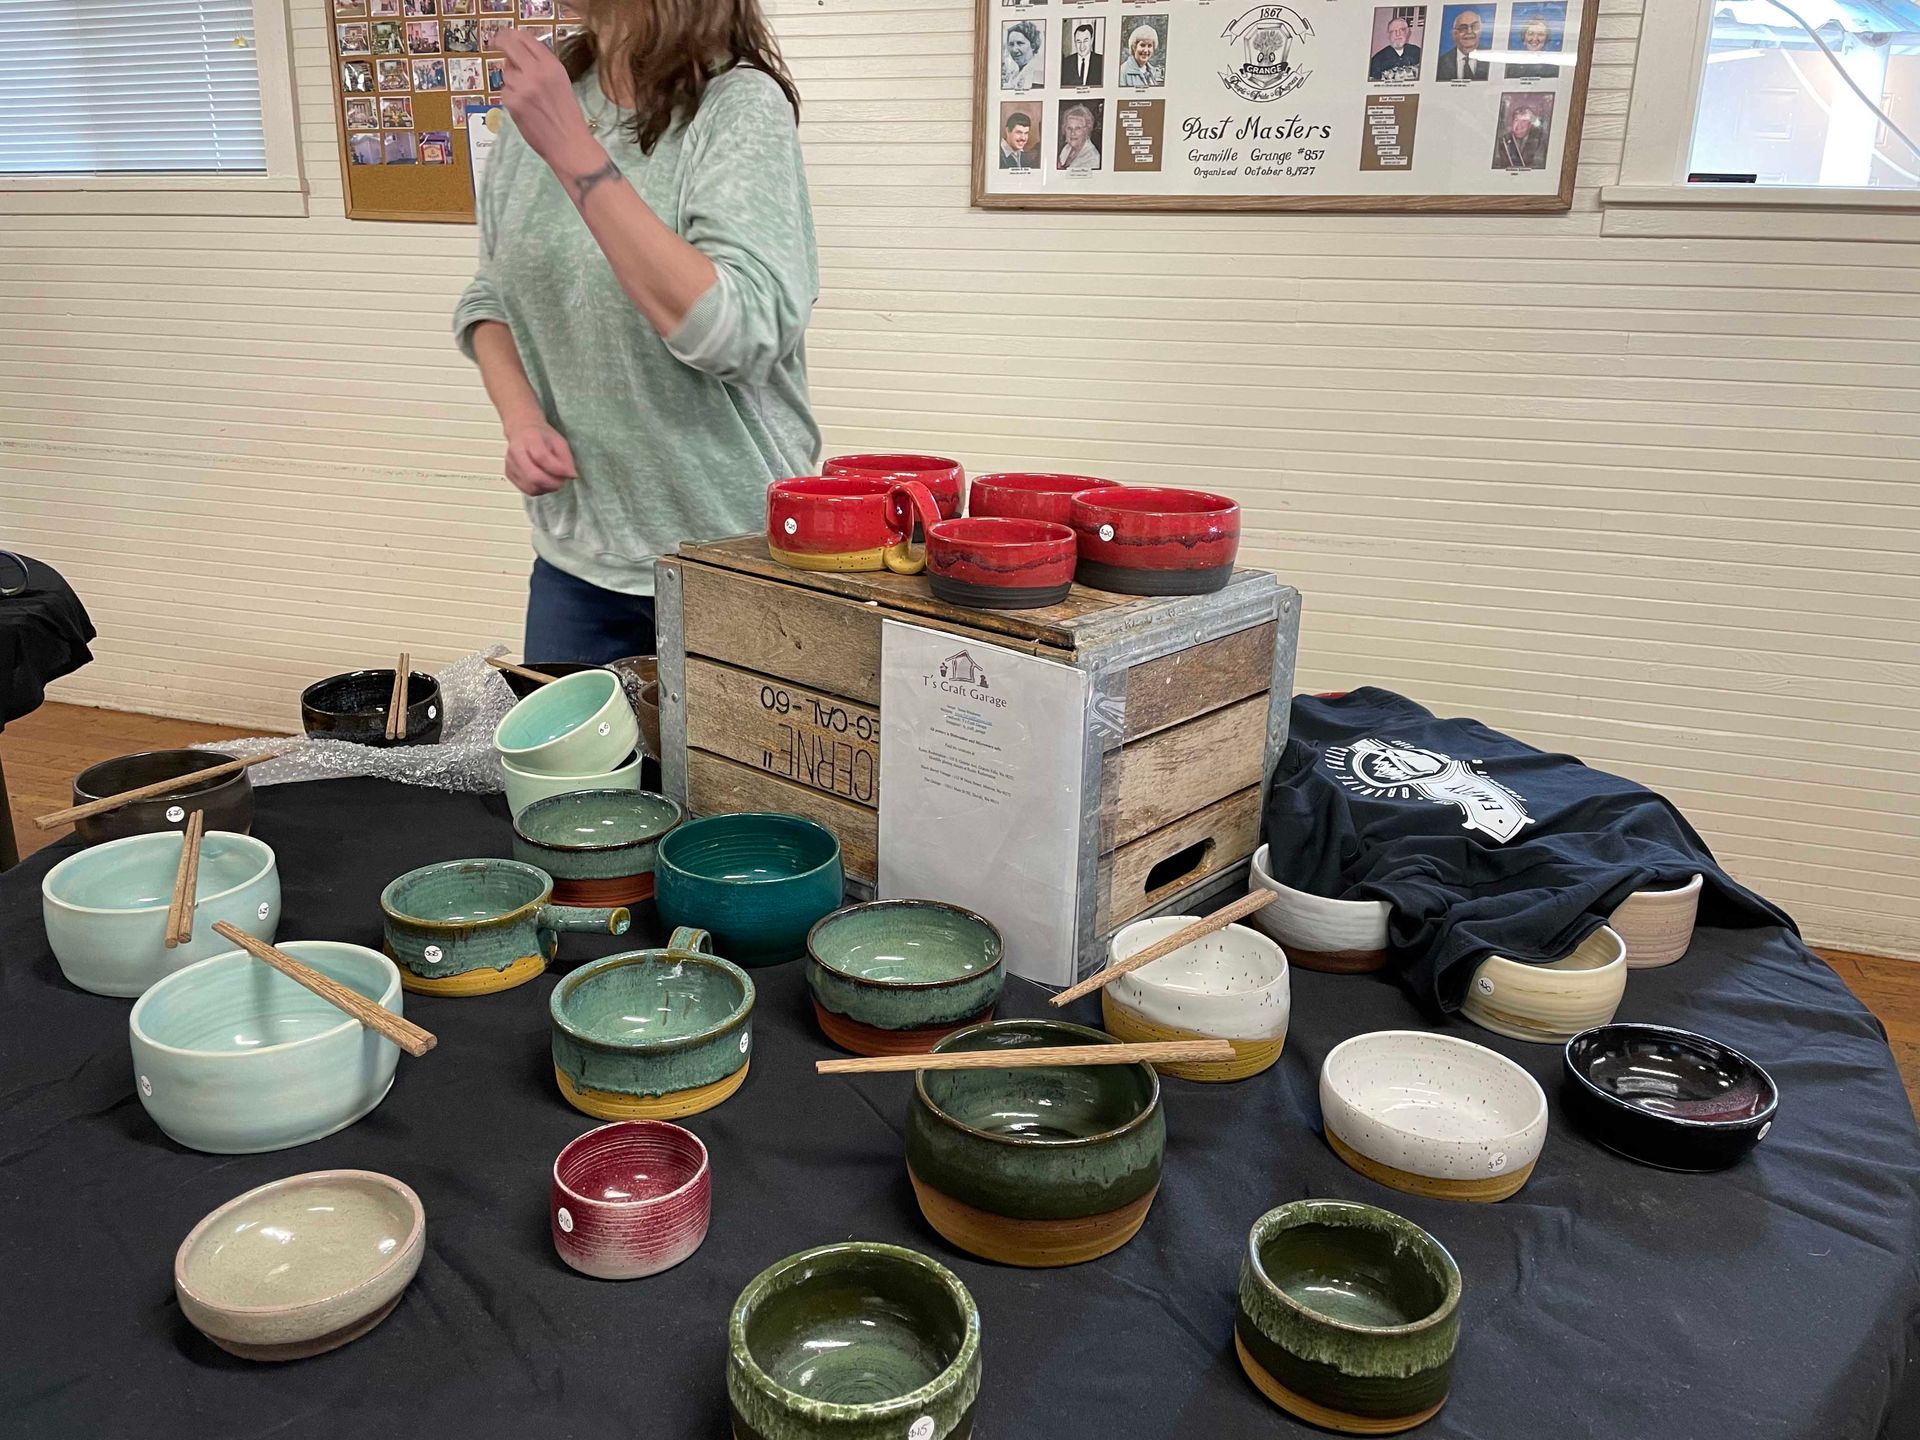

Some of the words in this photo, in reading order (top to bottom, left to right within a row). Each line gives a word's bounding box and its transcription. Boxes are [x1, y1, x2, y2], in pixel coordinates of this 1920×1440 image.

[1260, 8, 1283, 19] 1867
[1246, 65, 1282, 75] GRANGE
[1182, 115, 1234, 141] Past
[1236, 114, 1332, 140] Masters
[1188, 147, 1239, 162] Granville
[1250, 147, 1292, 165] Grange
[1297, 147, 1326, 161] #857
[1193, 167, 1238, 178] Organized
[1244, 166, 1283, 176] October
[923, 675, 937, 688] T's
[940, 681, 966, 697] Craft
[969, 689, 1008, 708] Garage
[1480, 979, 1491, 992] $20
[1488, 1154, 1505, 1169] $15
[559, 1213, 571, 1229] $10
[909, 1420, 931, 1438] $15
